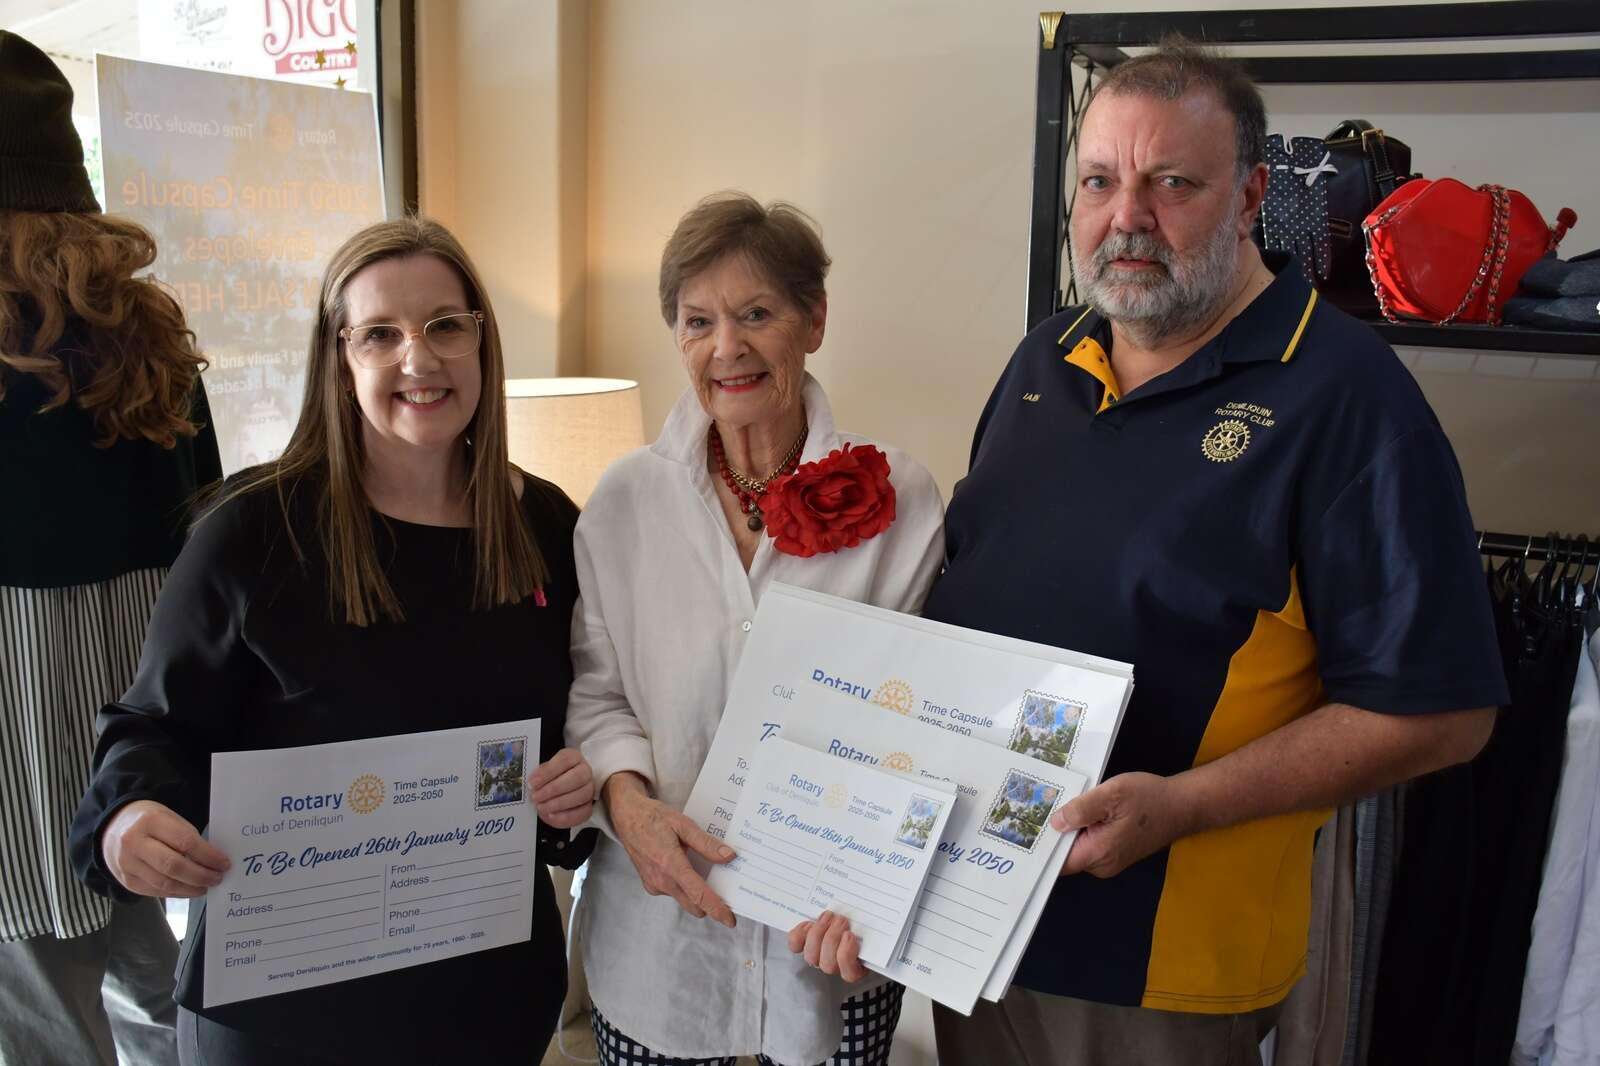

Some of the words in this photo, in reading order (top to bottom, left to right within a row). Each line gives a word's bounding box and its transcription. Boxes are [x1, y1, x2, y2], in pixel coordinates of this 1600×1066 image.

[1250, 415, 1275, 427] CLUB
[922, 700, 947, 716] Time
[949, 708, 993, 728] Capsule
[393, 780, 418, 791] Time
[420, 774, 459, 788] Capsule
[788, 774, 824, 797] Rotary
[280, 792, 343, 814] Rotary
[392, 788, 444, 805] 2025-2050
[241, 823, 269, 837] Club
[272, 819, 286, 833] of
[288, 814, 344, 831] Deniliquin
[757, 801, 770, 815] To
[769, 807, 785, 823] Be
[784, 814, 821, 836] Opened
[820, 827, 843, 844] 26th
[839, 834, 886, 864] January
[886, 851, 915, 870] 2050
[242, 853, 265, 876] To
[266, 850, 297, 876] Be
[299, 842, 363, 869] Opened
[364, 836, 402, 856] 26th
[400, 826, 471, 856] January
[473, 815, 515, 837] 2050
[391, 863, 417, 875] From
[966, 847, 1015, 875] 2050
[389, 875, 430, 890] Address
[228, 892, 242, 902] To
[226, 903, 274, 919] Address
[389, 907, 421, 921] Phone
[388, 923, 416, 937] Email
[225, 938, 263, 952] Phone
[225, 954, 257, 968] Email
[267, 970, 295, 981] Serving
[331, 960, 345, 969] and
[345, 958, 356, 967] the
